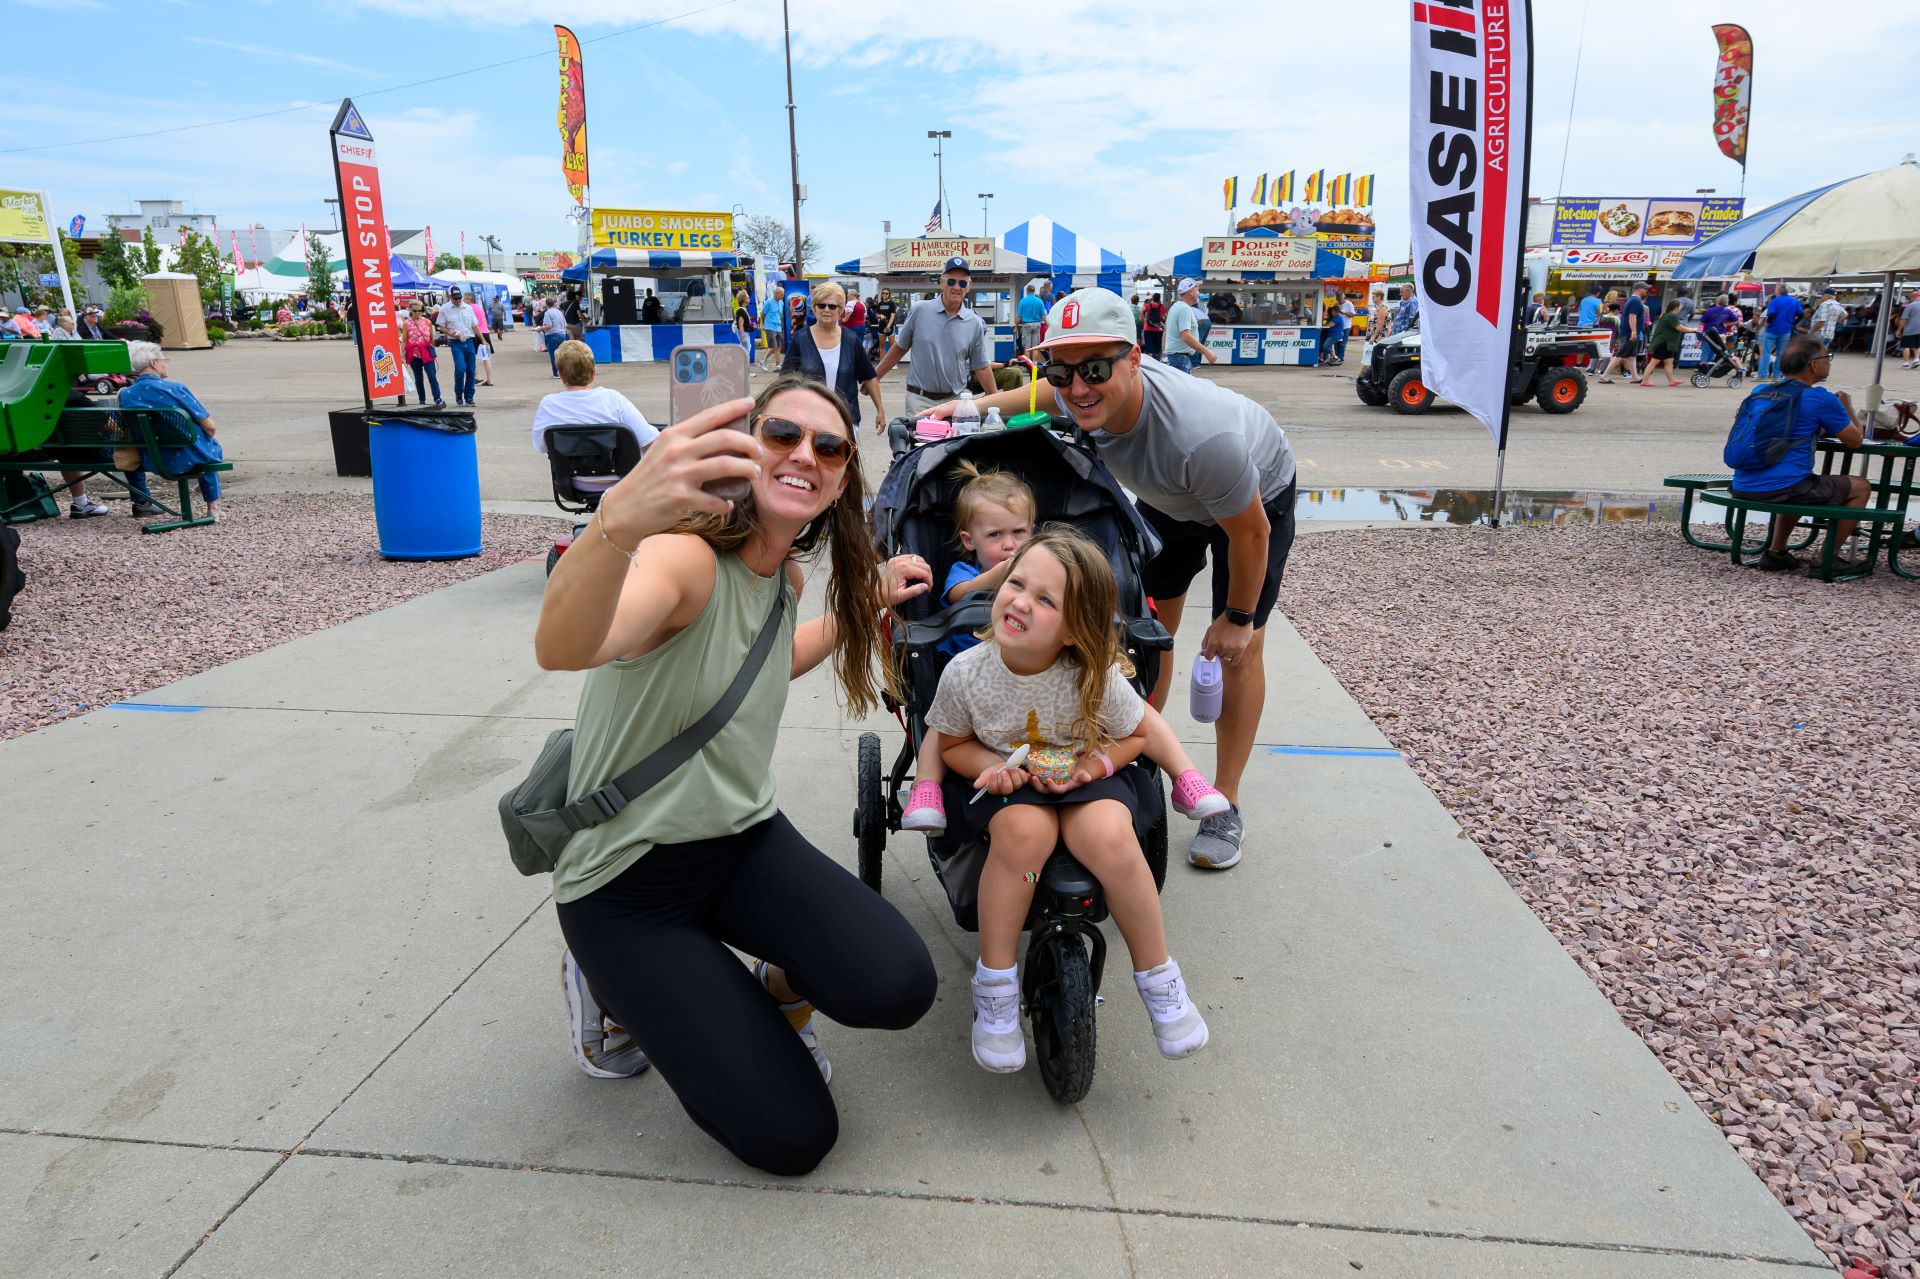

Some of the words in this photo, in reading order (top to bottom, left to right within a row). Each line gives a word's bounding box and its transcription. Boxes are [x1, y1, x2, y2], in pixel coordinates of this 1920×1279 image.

[558, 35, 570, 142] TURKEY
[1488, 4, 1506, 172] AGRICULTURE
[340, 144, 367, 157] CHIEF
[1422, 70, 1478, 307] CASE
[352, 175, 378, 248] STOP
[1557, 205, 1598, 220] Tot-chos
[1701, 205, 1741, 220] Grinder
[600, 214, 654, 231] JUMBO
[660, 217, 725, 232] SMOKED
[608, 231, 674, 247] TURKEY
[680, 233, 722, 248] LEGS
[1231, 240, 1289, 256] POLISH
[911, 240, 970, 257] HAMBURGER
[927, 249, 954, 257] BASKET
[1240, 249, 1288, 259] sausage
[889, 260, 942, 268] CHEESEBURGERS
[974, 259, 992, 267] FRIES
[1205, 259, 1228, 267] FOOT
[1231, 259, 1259, 268] LONGS
[1266, 260, 1283, 268] HOT
[1288, 260, 1312, 268] DOGS
[363, 258, 389, 334] TRAM
[225, 298, 233, 316] EARL
